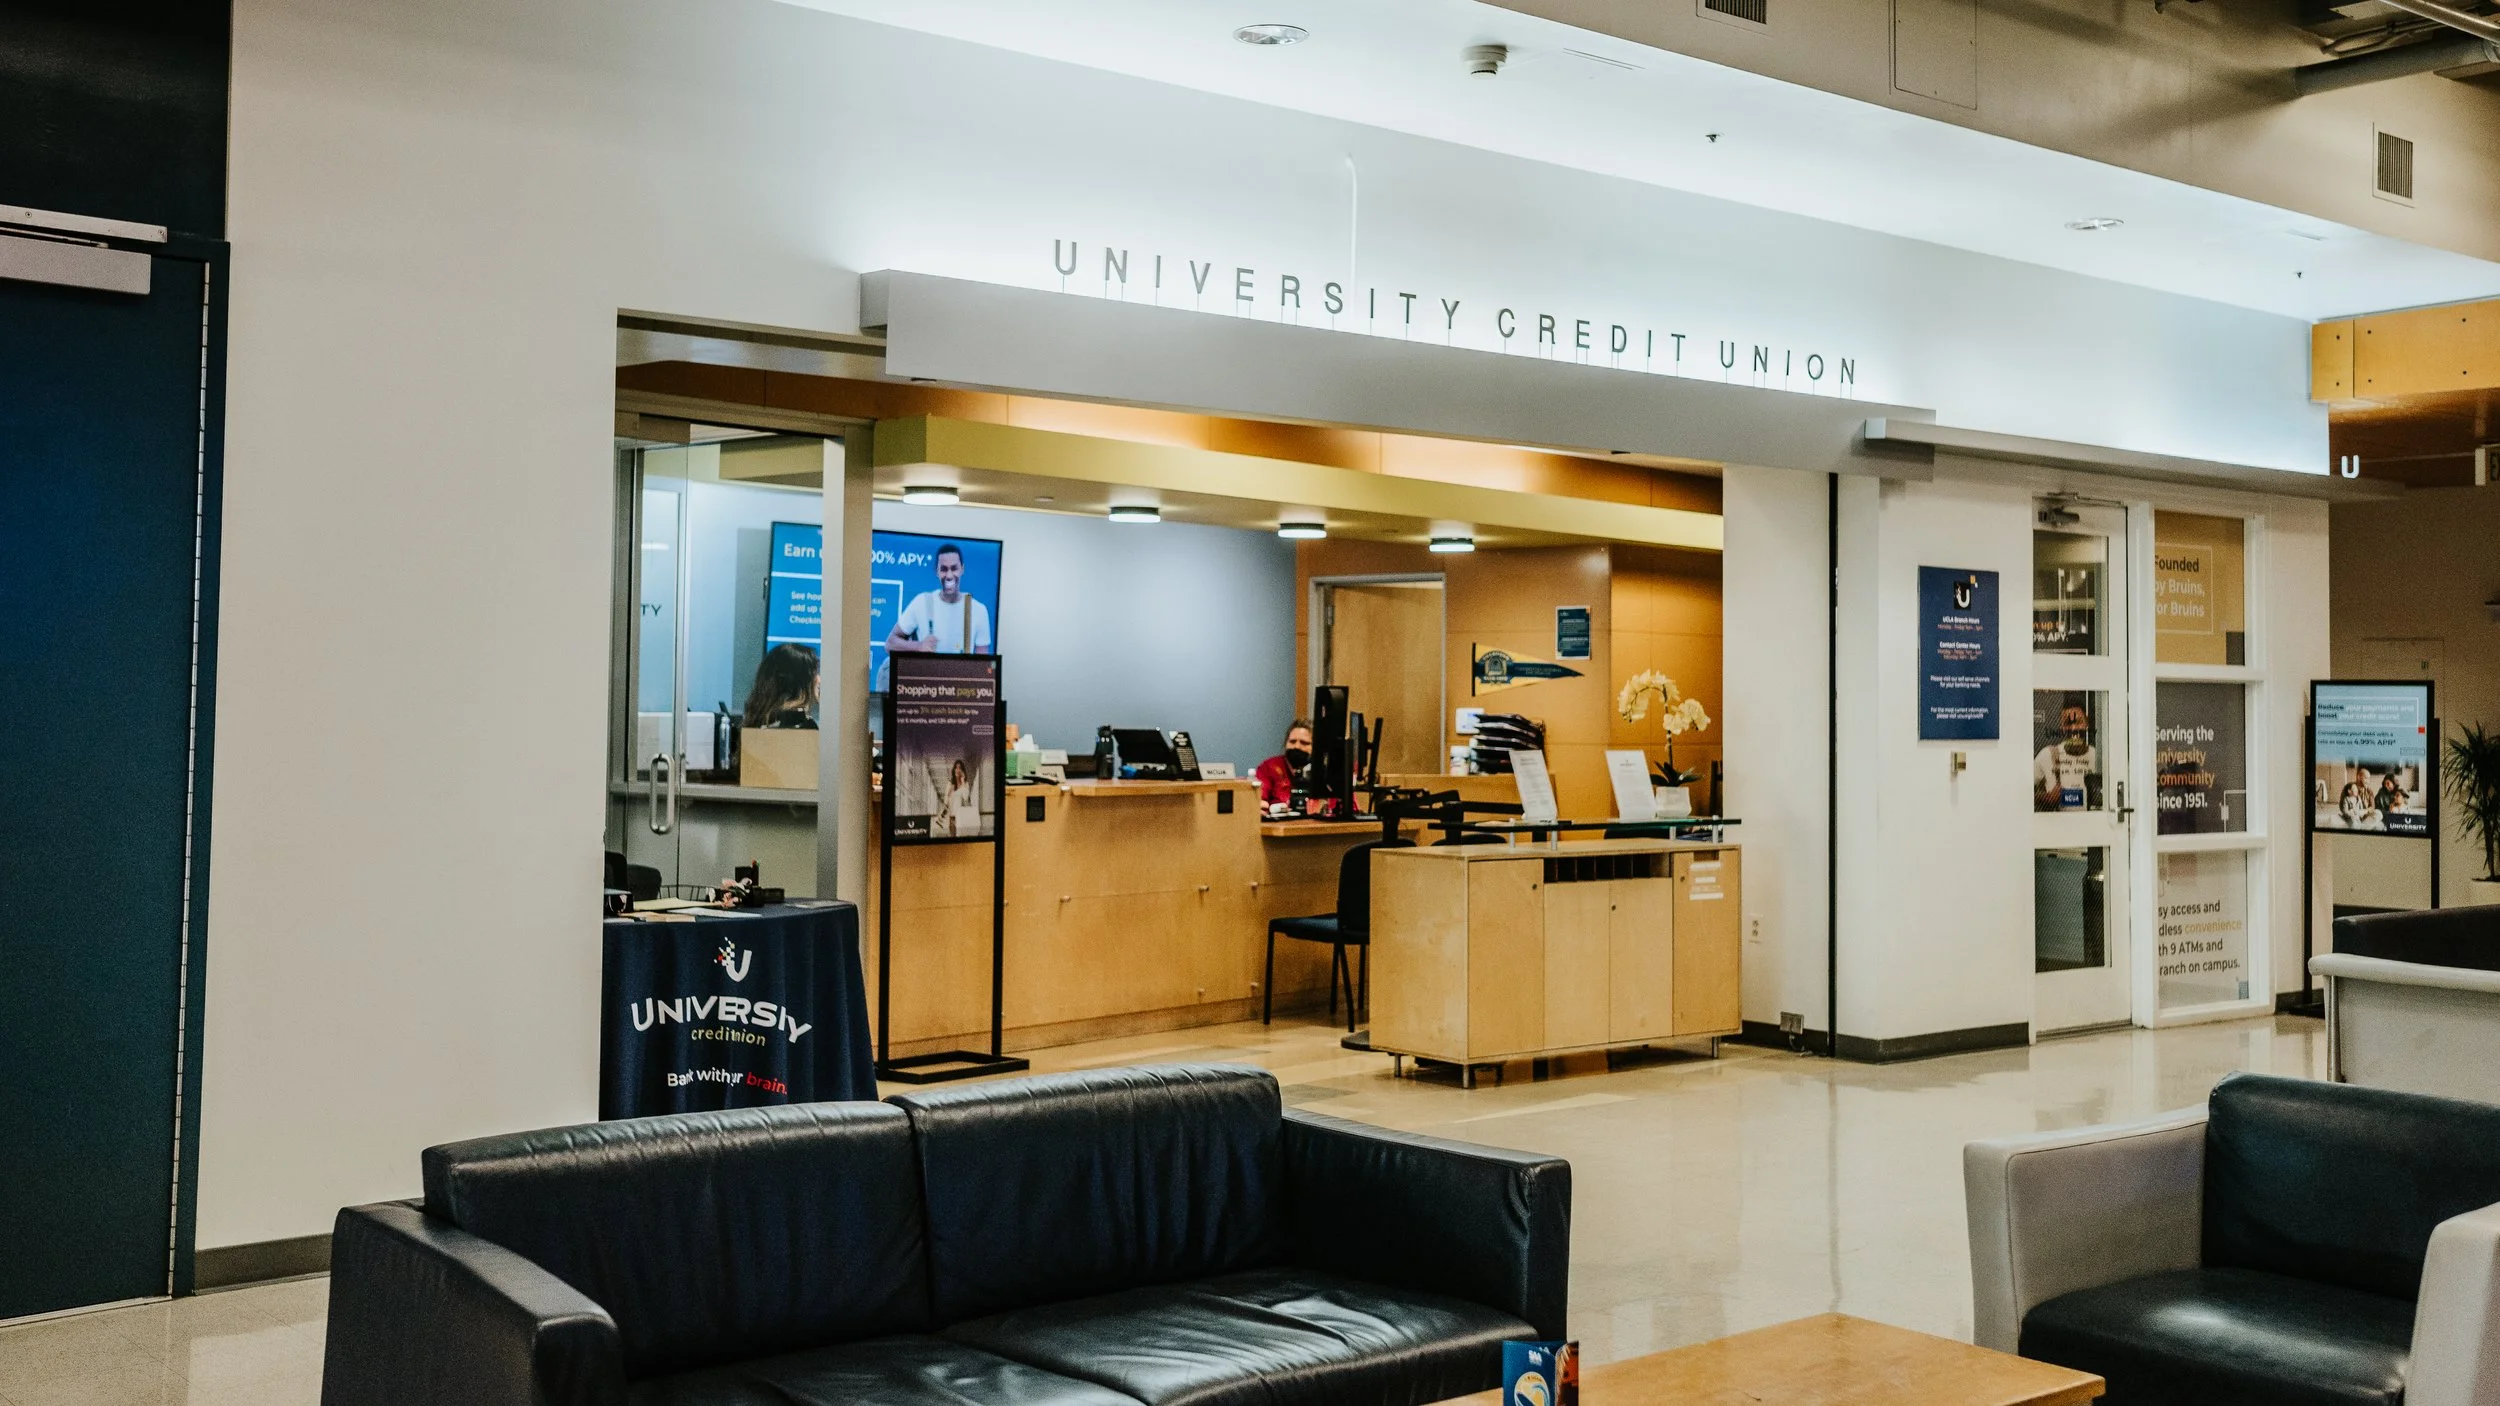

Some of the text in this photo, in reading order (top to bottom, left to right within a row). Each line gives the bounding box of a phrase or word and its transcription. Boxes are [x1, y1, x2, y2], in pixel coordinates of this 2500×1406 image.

[1054, 239, 1856, 385] UNIVERSITY CREDIT UNION
[2341, 454, 2360, 479] U
[784, 543, 815, 558] Earn
[2169, 578, 2205, 597] Bruins,
[2171, 601, 2204, 617] Bruins
[789, 615, 821, 624] Checkin
[897, 684, 994, 699] Shopping that pays you.
[2156, 725, 2214, 744] Serving the
[2157, 770, 2215, 787] ommunity
[2184, 792, 2208, 808] 1951.
[2170, 902, 2201, 916] access
[2203, 899, 2221, 914] and
[2185, 918, 2242, 934] convenience
[2170, 941, 2177, 956] 9
[2178, 940, 2204, 954] ATMs
[2206, 937, 2223, 952] and
[2188, 962, 2200, 974] on
[2202, 958, 2240, 973] campus.
[746, 1071, 788, 1095] brain.
